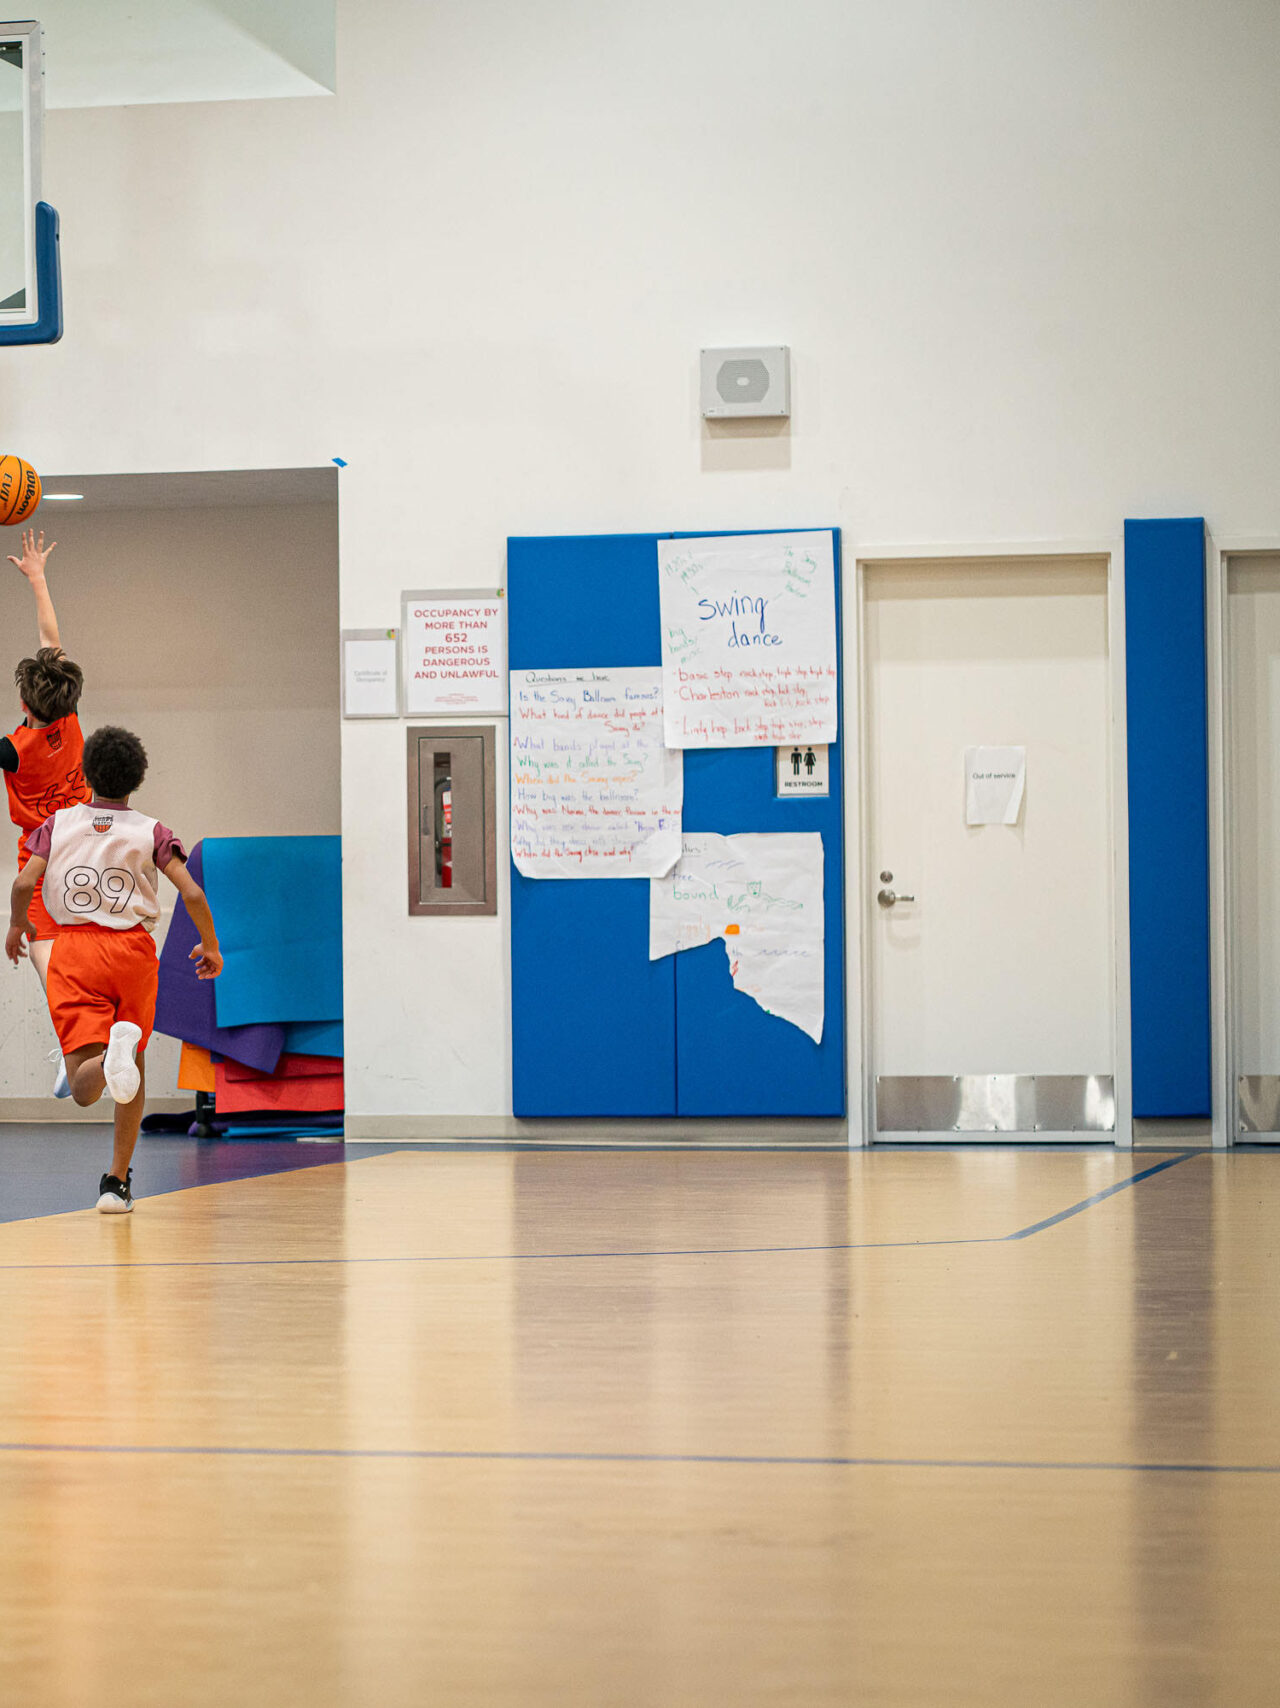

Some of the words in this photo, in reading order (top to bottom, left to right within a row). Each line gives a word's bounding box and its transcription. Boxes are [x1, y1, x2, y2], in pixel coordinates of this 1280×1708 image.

[414, 608, 481, 618] OCCUPANCY
[484, 608, 499, 617] BY
[425, 621, 455, 630] MORE
[459, 620, 488, 629] THAN
[445, 633, 468, 643] 652
[727, 620, 783, 649] dance
[425, 645, 475, 655] PERSONS
[478, 645, 488, 654] IS
[423, 657, 490, 667] DANGEROUS
[414, 671, 437, 680] AND
[440, 670, 499, 679] UNLAWFUL
[526, 671, 567, 683] Questions
[678, 667, 709, 682] basic
[714, 666, 733, 681] step
[520, 691, 528, 702] Is
[534, 691, 546, 702] the
[678, 685, 740, 701] Charleston
[520, 707, 547, 719] What
[575, 707, 584, 719] of
[614, 708, 625, 719] did
[519, 736, 544, 750] What
[517, 755, 540, 776] Why
[544, 760, 560, 769] was
[515, 773, 544, 785] When
[547, 774, 560, 785] did
[564, 773, 576, 784] the
[784, 780, 823, 788] RESTROOM
[518, 787, 537, 800] How
[515, 805, 539, 820] Why
[541, 848, 552, 858] did
[603, 847, 616, 857] and
[63, 865, 136, 914] 89
[672, 884, 719, 900] bound
